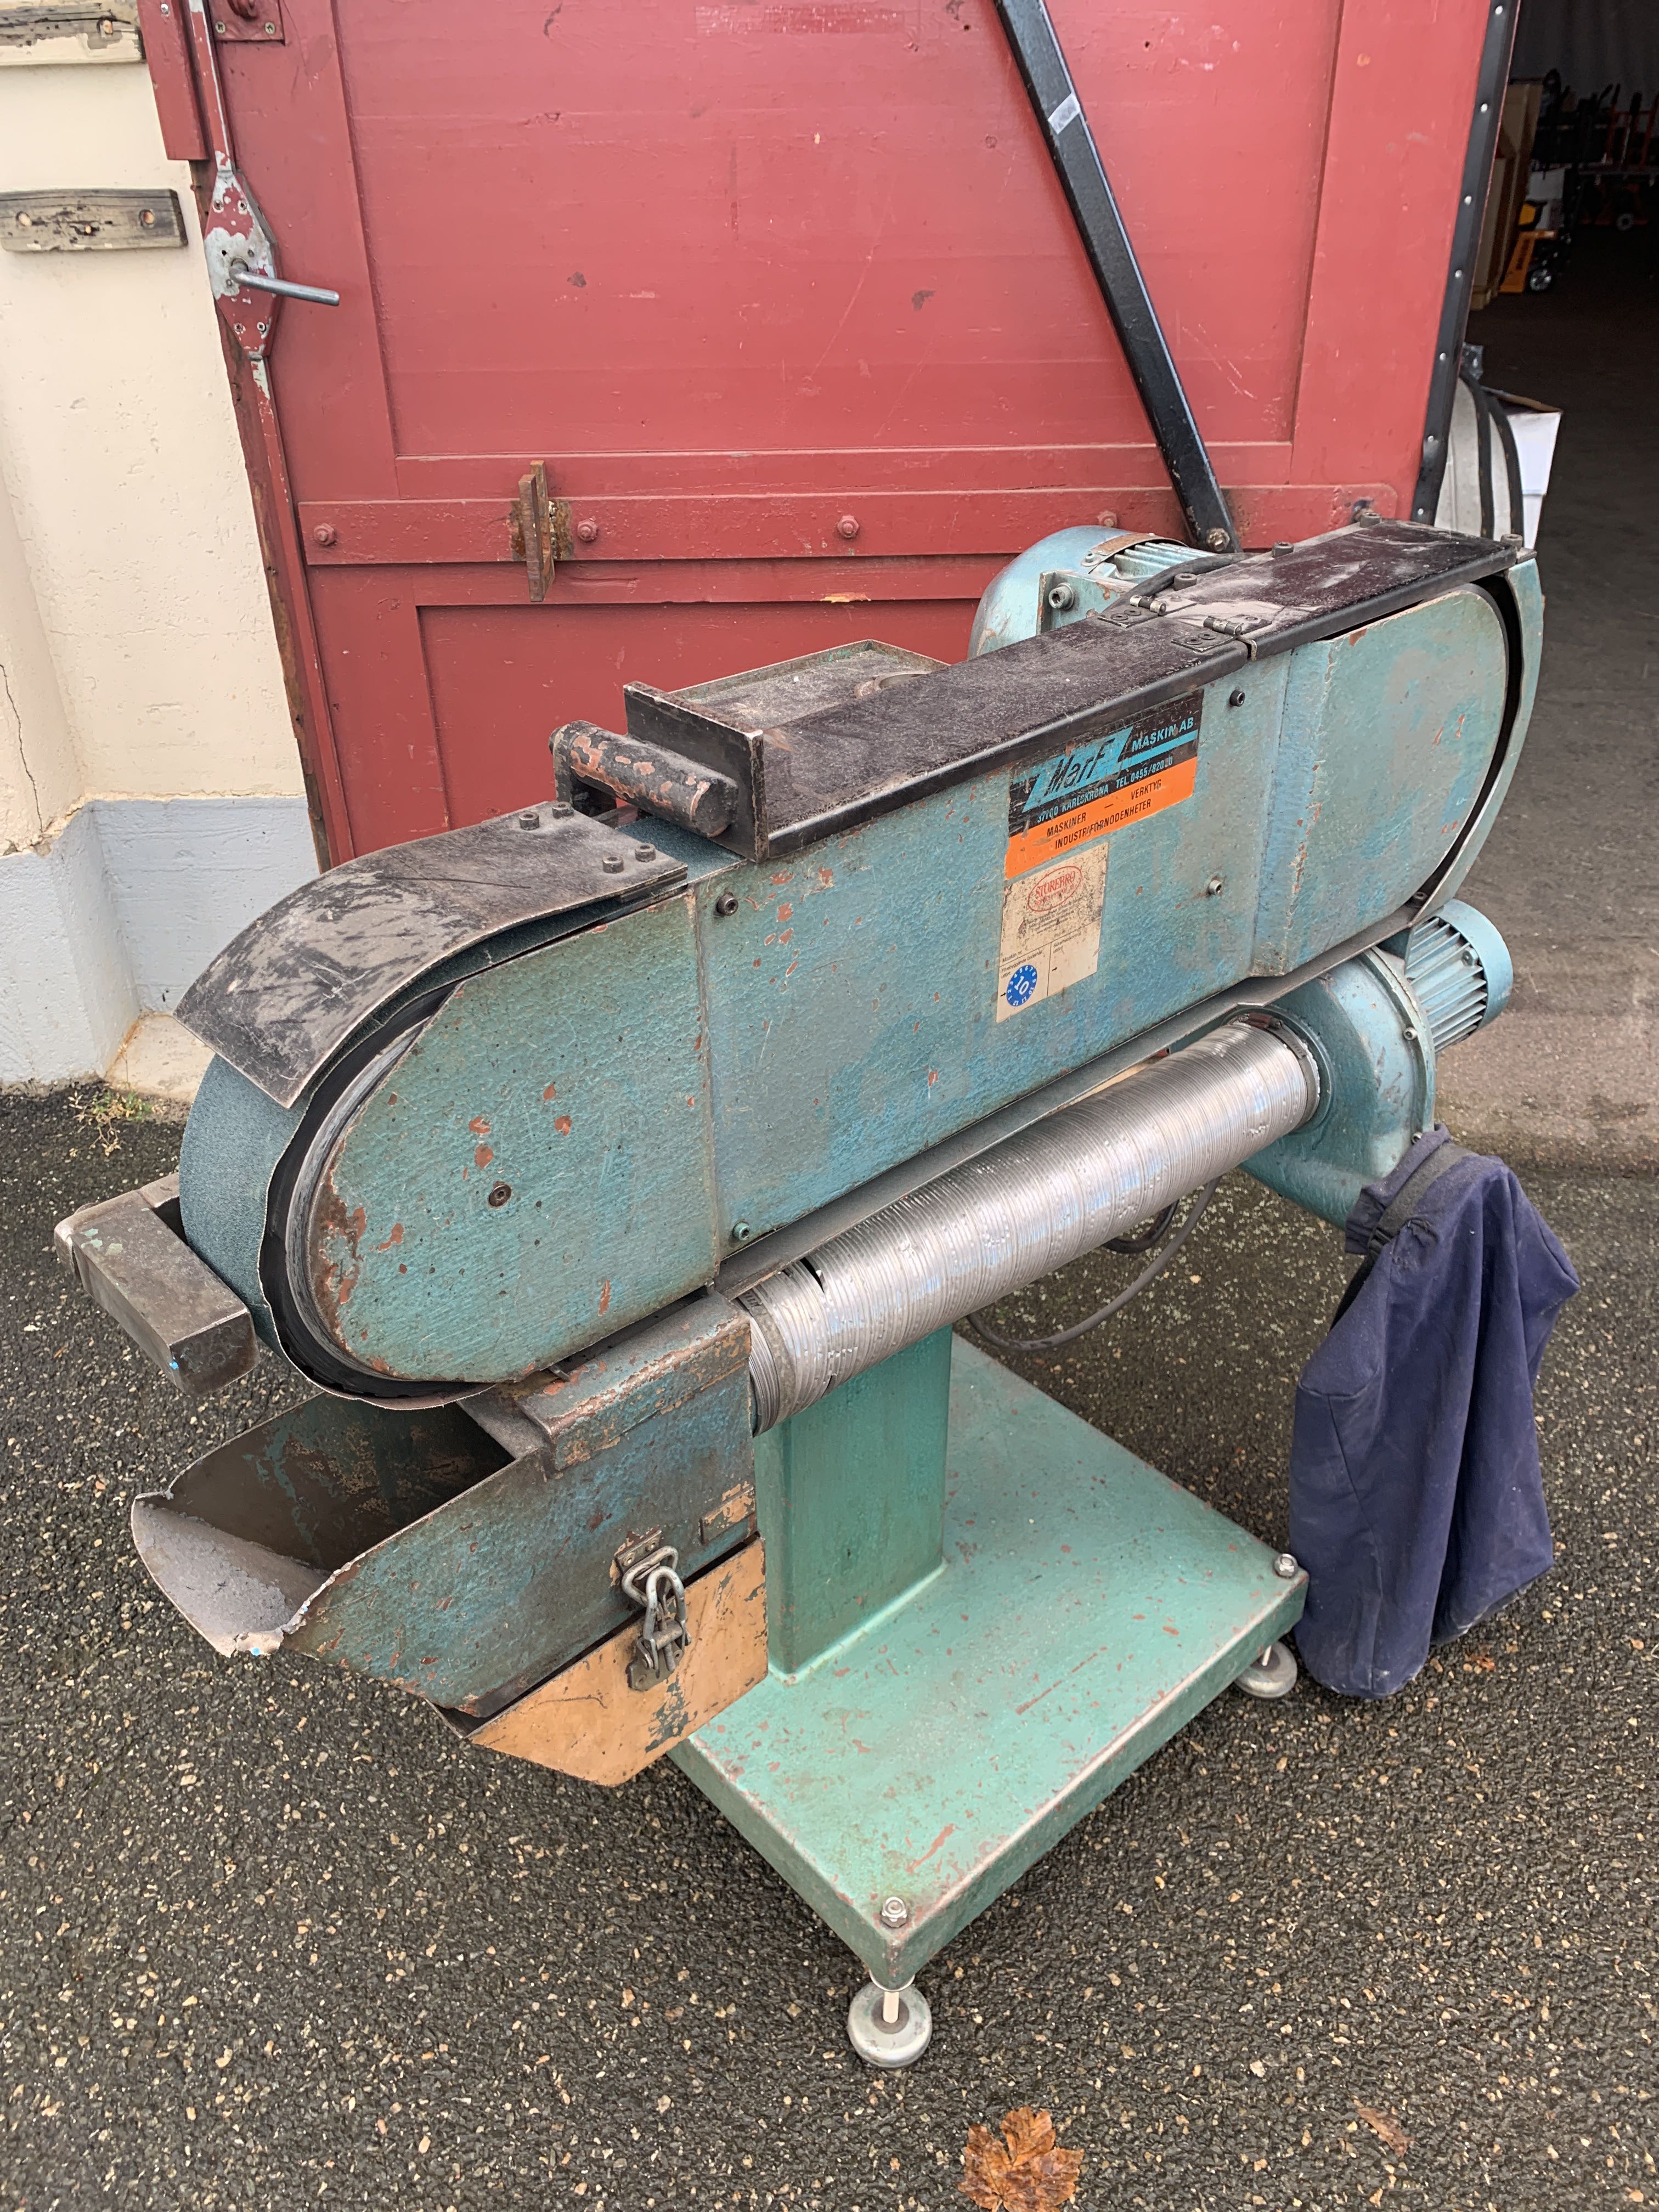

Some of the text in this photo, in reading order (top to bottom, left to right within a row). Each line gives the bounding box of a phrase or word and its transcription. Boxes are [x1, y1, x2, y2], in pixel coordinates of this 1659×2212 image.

[1132, 724, 1177, 752] MASKIN
[1179, 716, 1194, 732] AB
[1062, 785, 1109, 812] KARLSKRONA
[1116, 776, 1130, 789] TEL.
[1131, 756, 1173, 782] 0455/8200
[1047, 812, 1086, 837] MASKINER
[1131, 779, 1162, 800] VERKTYG
[1036, 871, 1075, 897] STOREBRO
[1014, 975, 1029, 995] 10
